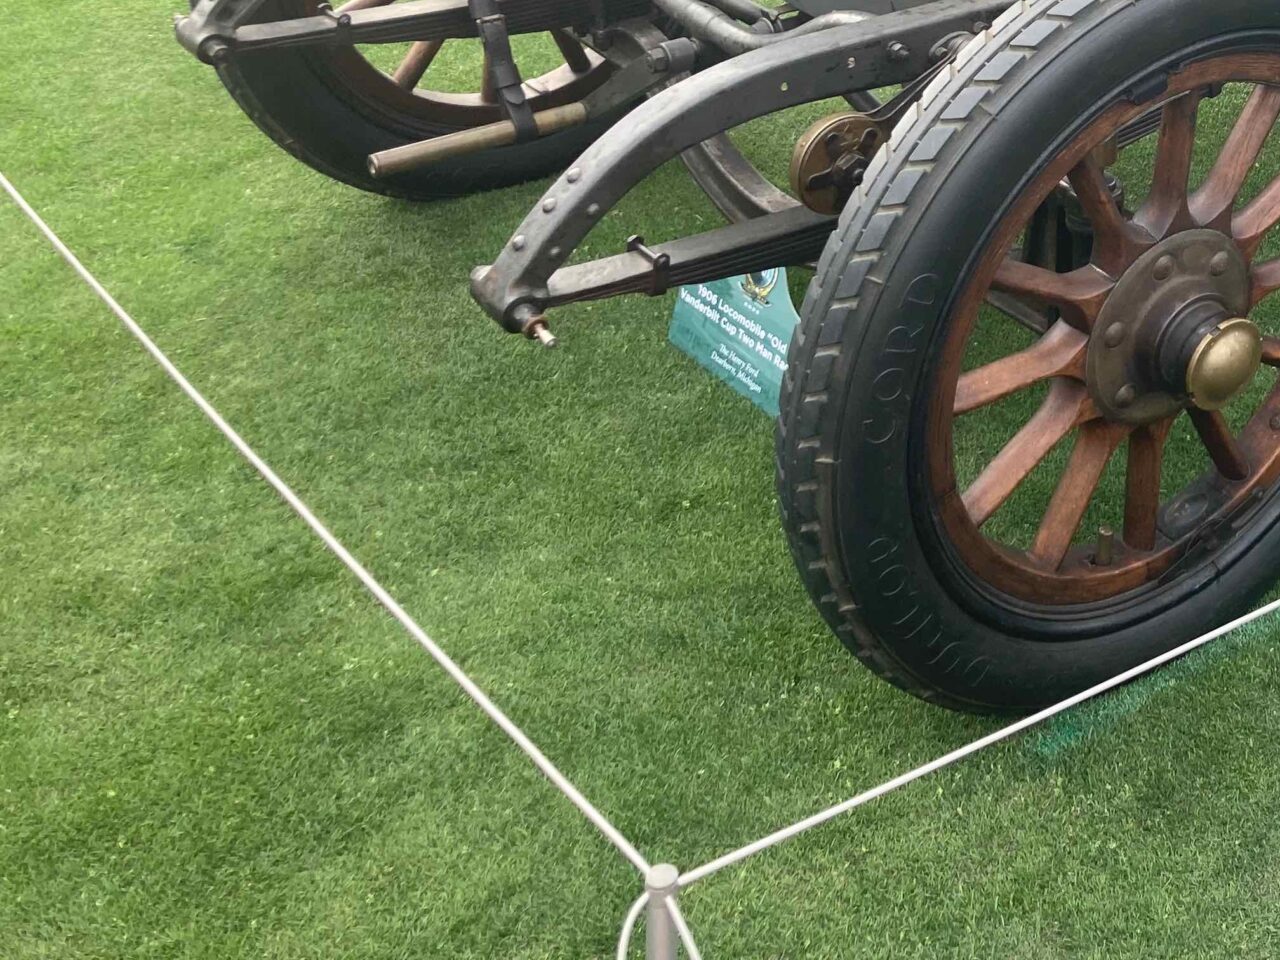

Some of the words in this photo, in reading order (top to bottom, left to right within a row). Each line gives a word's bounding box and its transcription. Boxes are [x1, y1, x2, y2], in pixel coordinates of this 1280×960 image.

[680, 287, 720, 323] Vanderbilt
[720, 316, 737, 335] Cup
[738, 328, 755, 348] Two
[755, 341, 773, 361] Man
[718, 298, 766, 339] Locomobile
[861, 271, 940, 445] CORD
